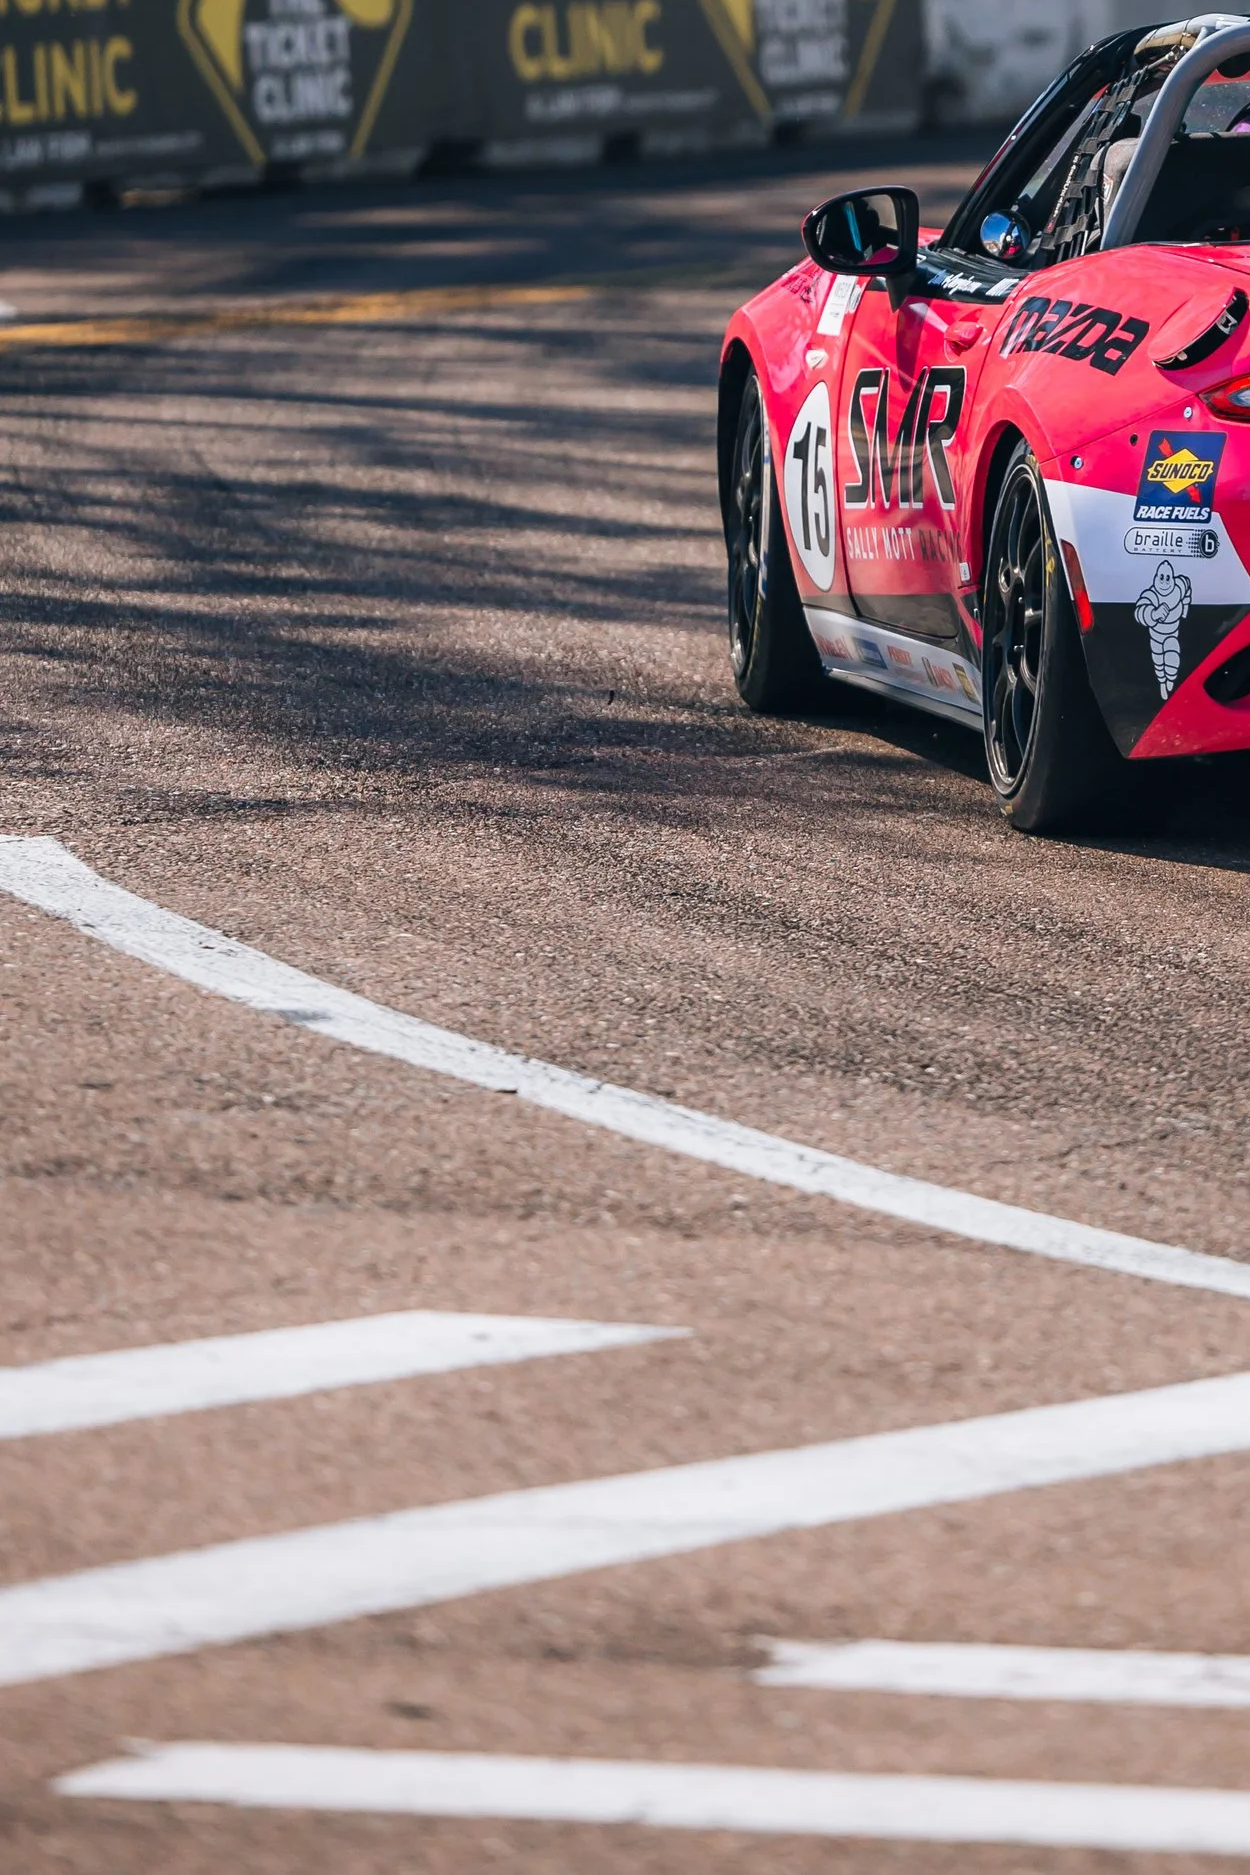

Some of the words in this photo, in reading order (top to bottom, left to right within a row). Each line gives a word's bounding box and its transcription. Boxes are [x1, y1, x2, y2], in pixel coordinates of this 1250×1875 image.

[0, 35, 137, 124] LINIC
[253, 69, 354, 124] CLINIC
[844, 366, 967, 510] SMR
[793, 422, 830, 557] 15
[1150, 463, 1211, 479] SUNOCO
[1137, 506, 1172, 519] RACE
[1172, 507, 1211, 520] FUELS
[846, 527, 879, 560] SALLY
[882, 527, 915, 560] MOTT
[1135, 531, 1183, 547] braille
